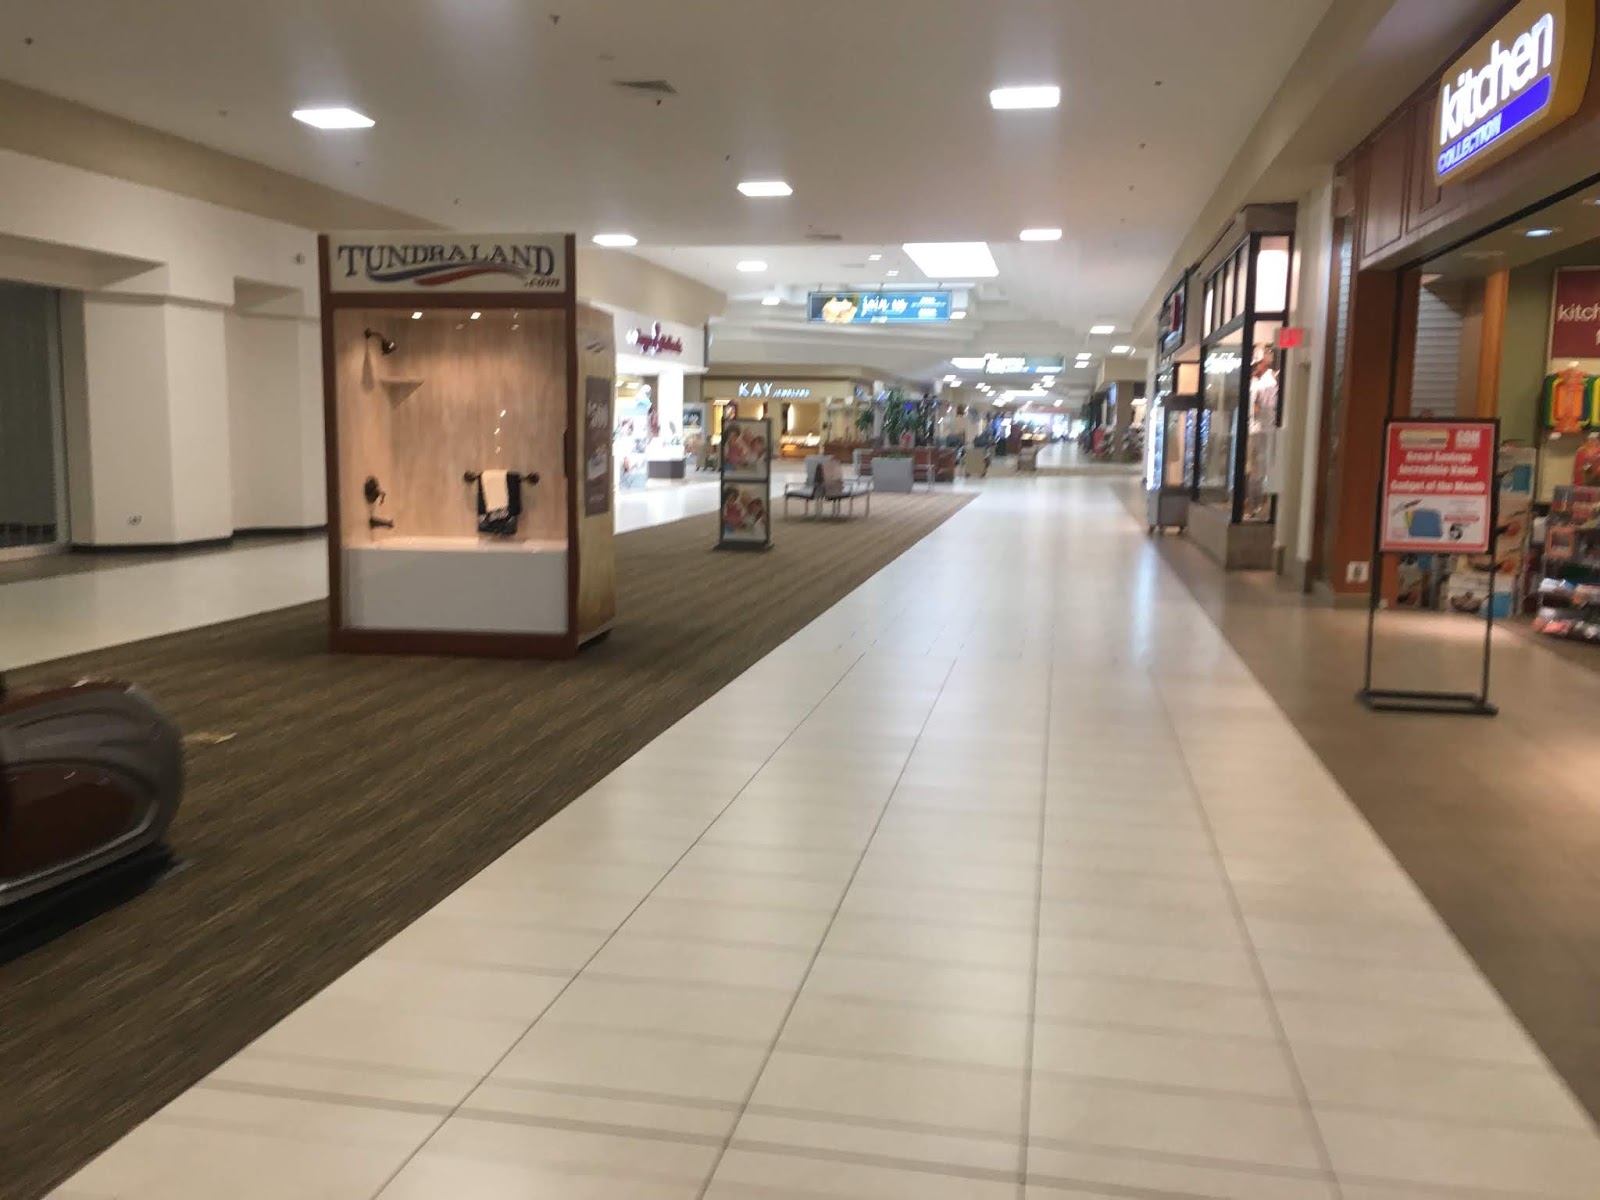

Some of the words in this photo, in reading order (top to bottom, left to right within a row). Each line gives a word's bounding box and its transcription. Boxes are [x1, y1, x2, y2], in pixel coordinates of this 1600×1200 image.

[1440, 13, 1553, 145] kitchen
[1437, 113, 1502, 172] COLLECTION
[337, 243, 555, 277] TUNDRALAND
[738, 382, 773, 398] KAY
